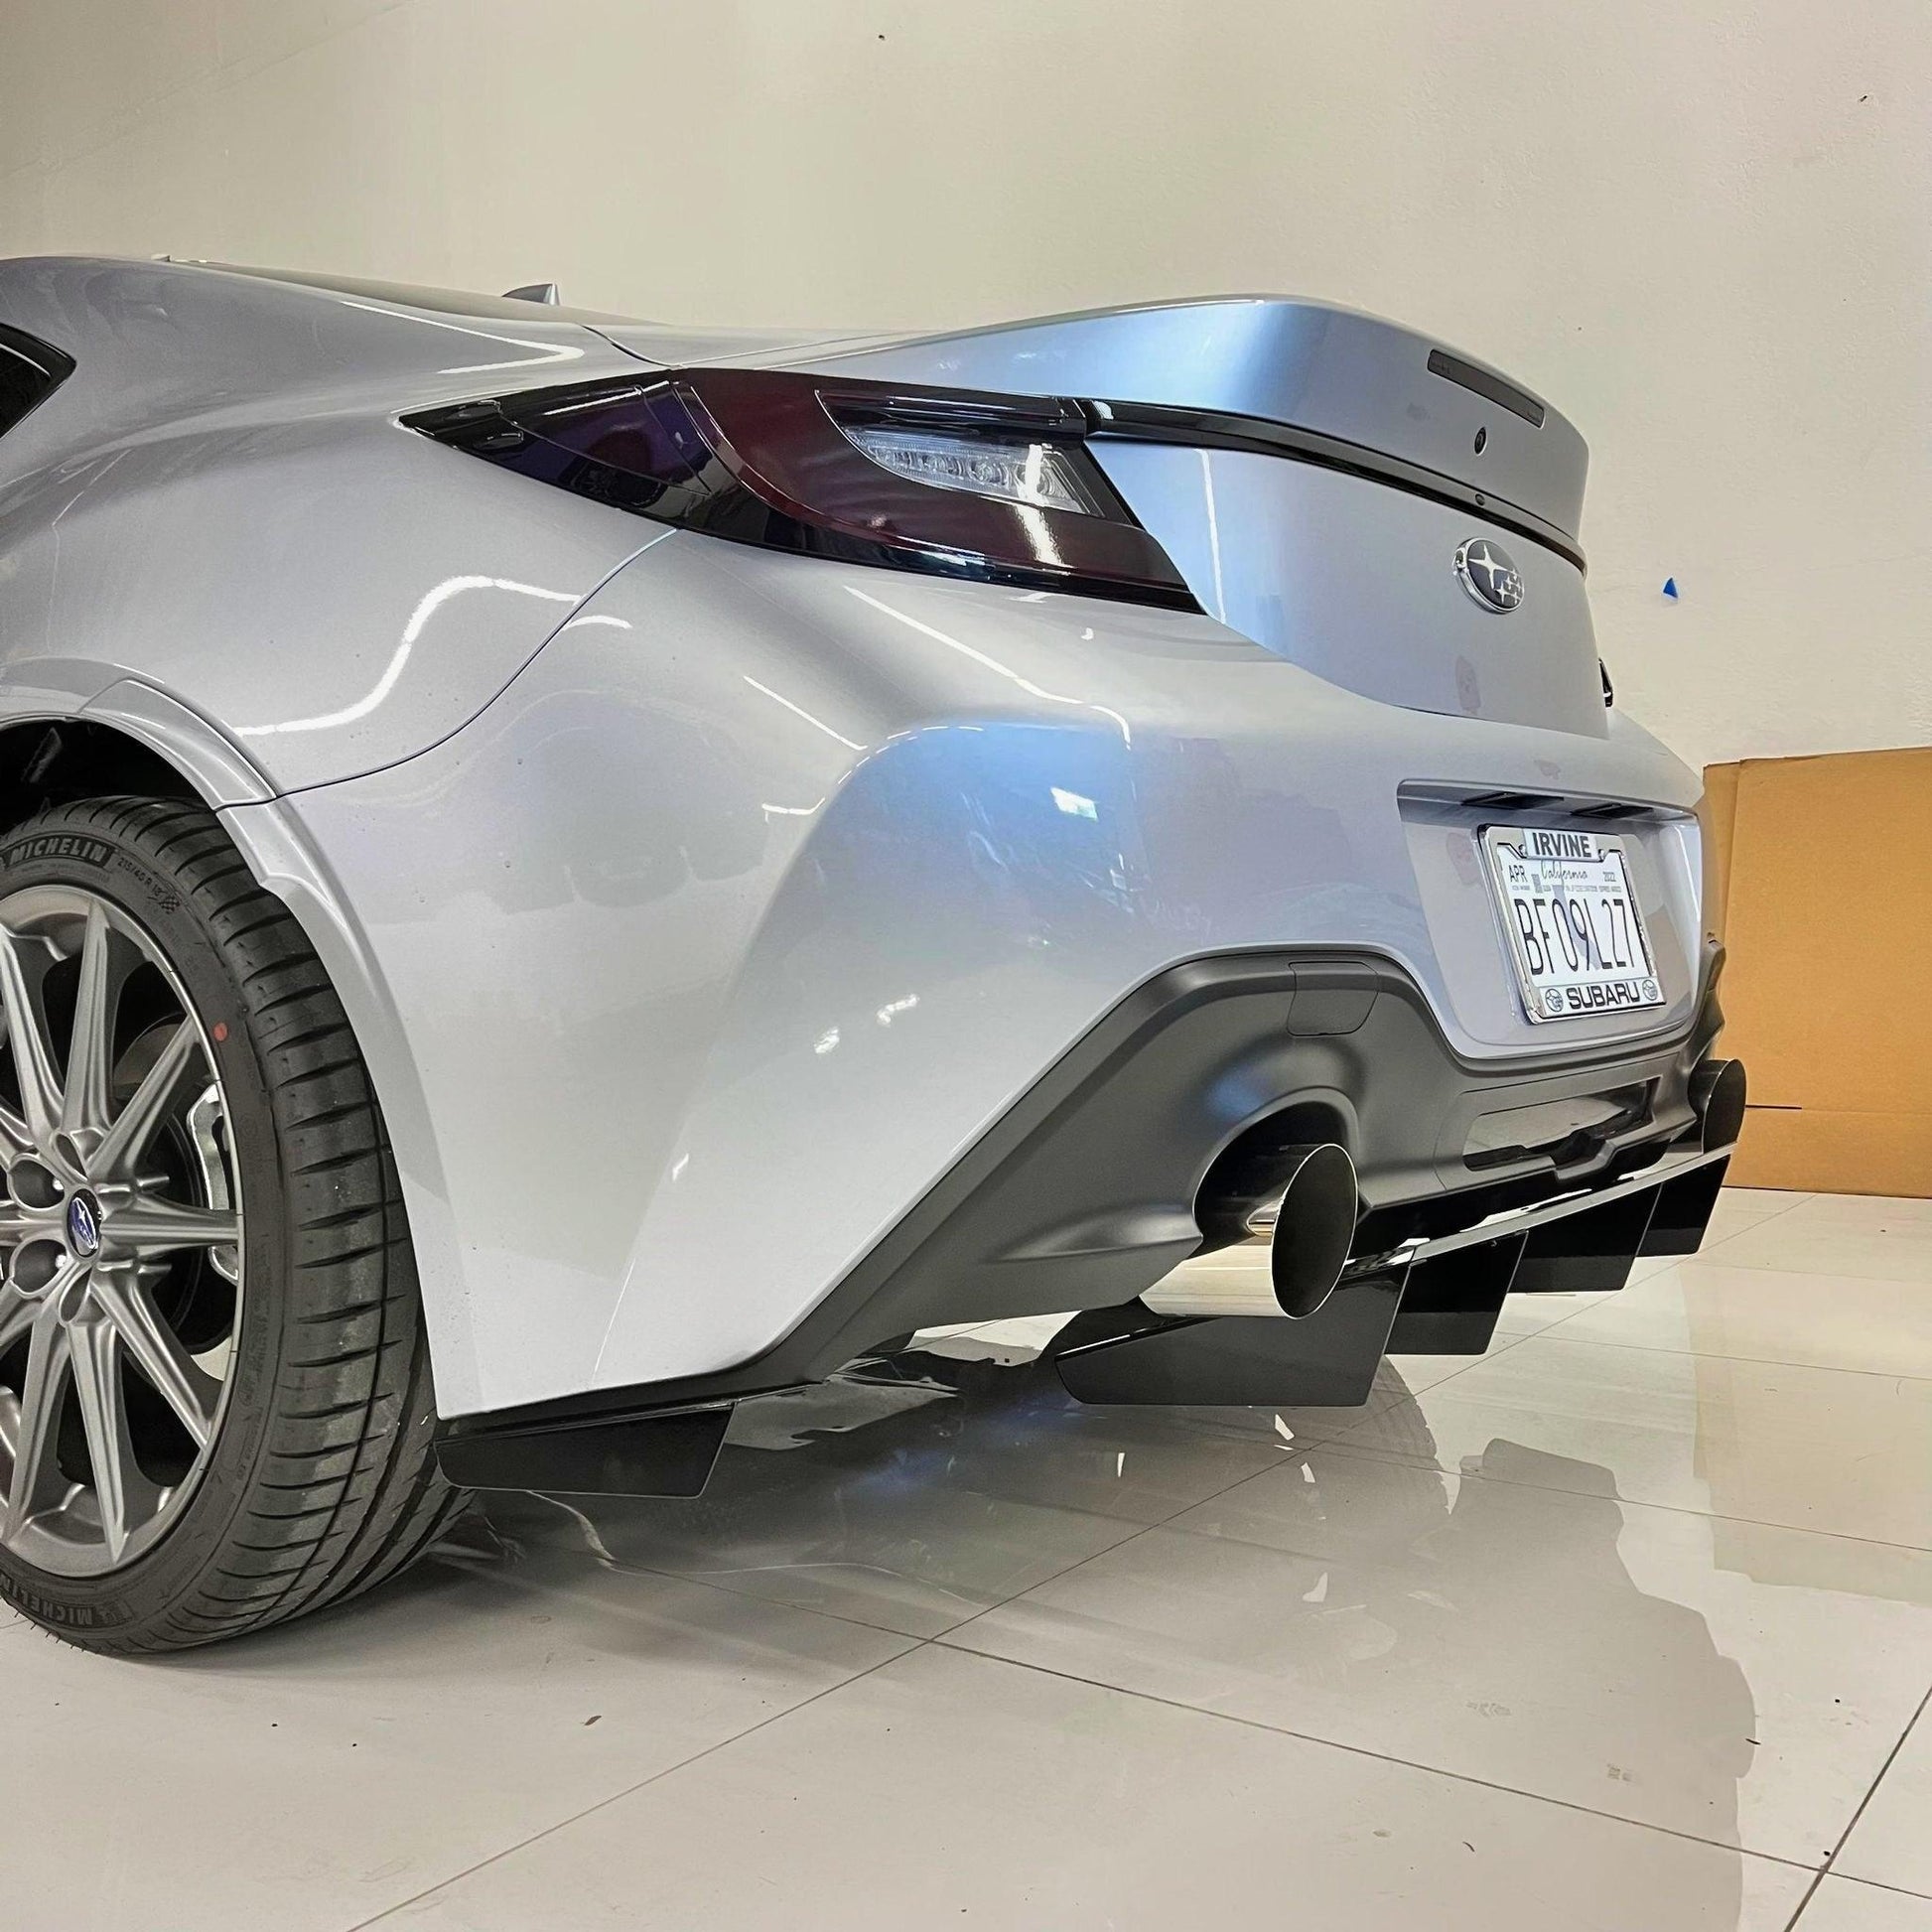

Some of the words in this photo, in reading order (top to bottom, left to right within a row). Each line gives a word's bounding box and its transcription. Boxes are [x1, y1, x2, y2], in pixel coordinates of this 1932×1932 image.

[10, 837, 108, 865] MICHELIN
[1532, 832, 1592, 858] IRVINE
[1508, 865, 1527, 883] APR
[1514, 897, 1635, 976] BF09L27
[1567, 982, 1641, 1010] SUBARU
